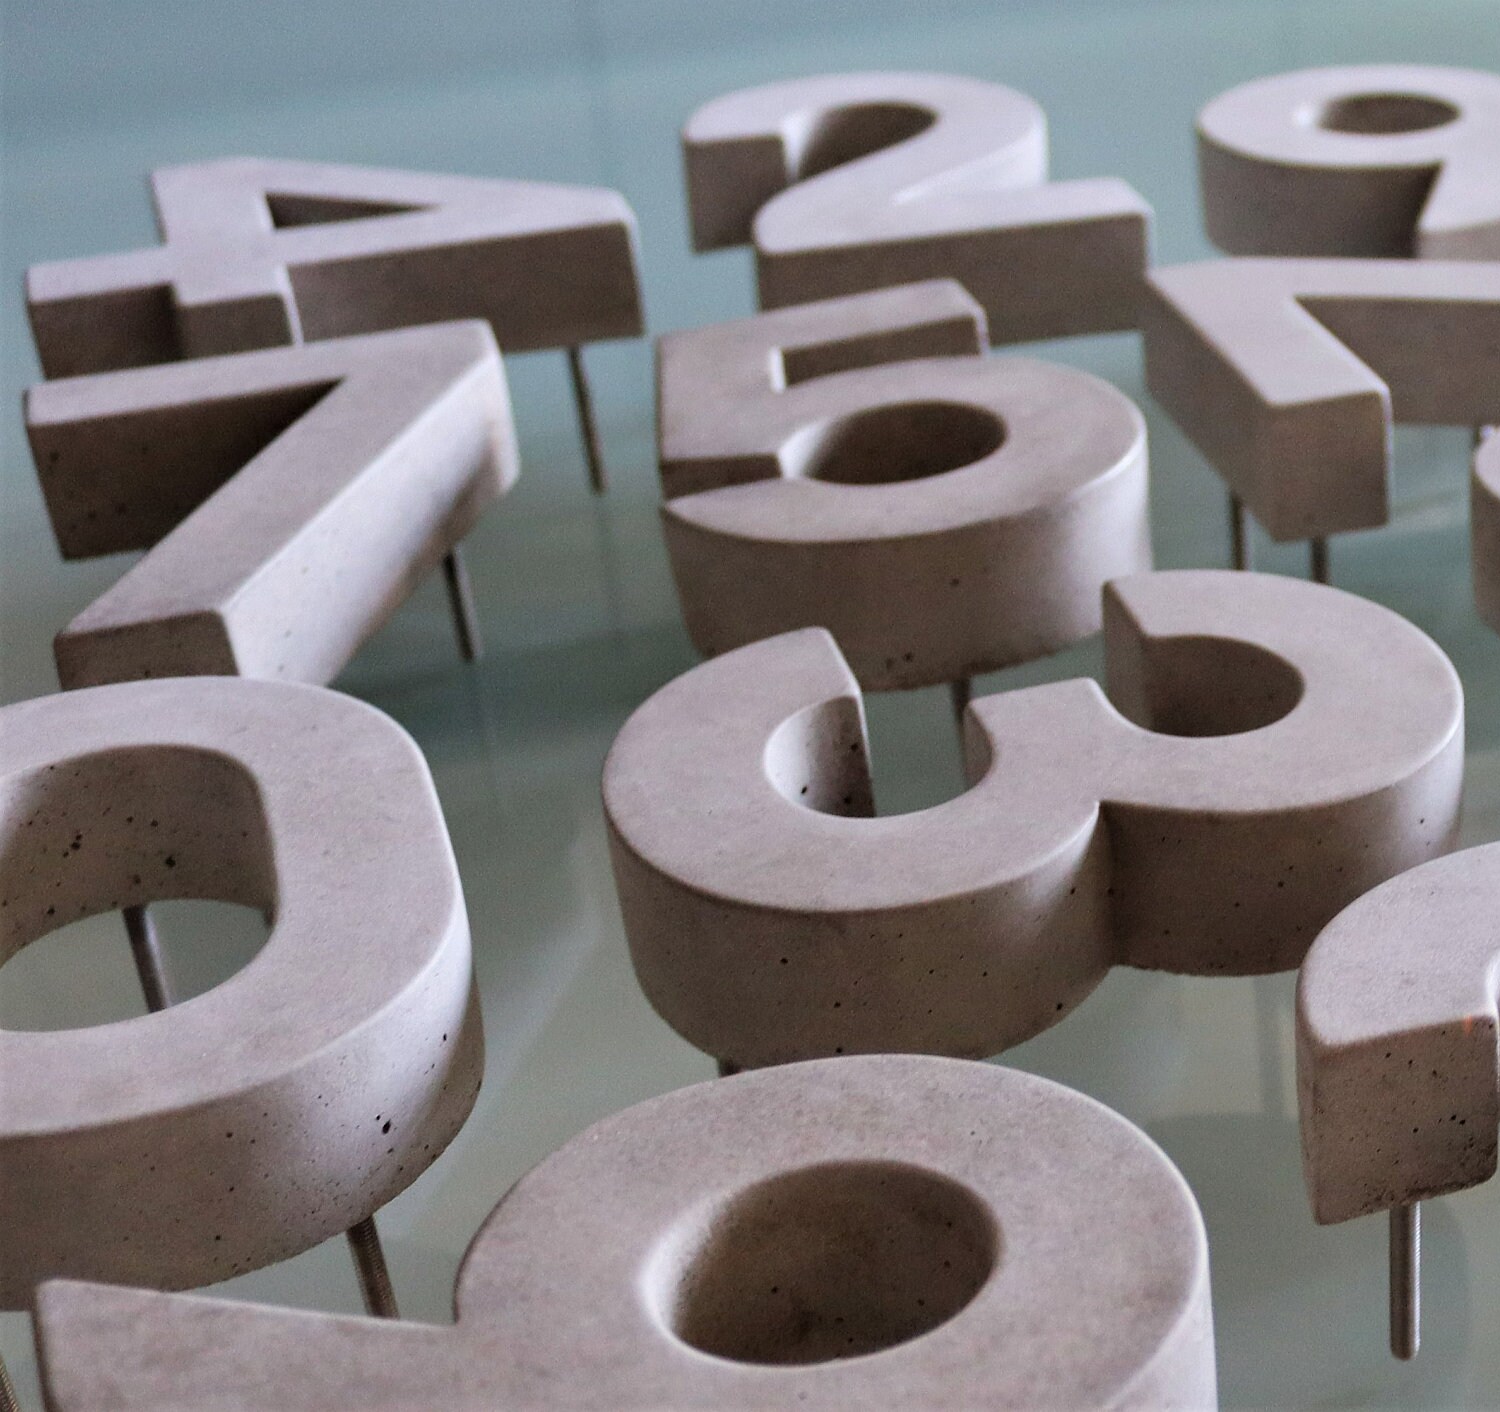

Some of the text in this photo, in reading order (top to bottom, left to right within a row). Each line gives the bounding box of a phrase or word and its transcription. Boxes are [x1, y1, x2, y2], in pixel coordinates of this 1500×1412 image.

[25, 157, 645, 380] 4
[682, 71, 1157, 332] 2
[23, 319, 520, 685] 7
[655, 278, 1150, 690] 5
[603, 568, 1464, 1062] 3
